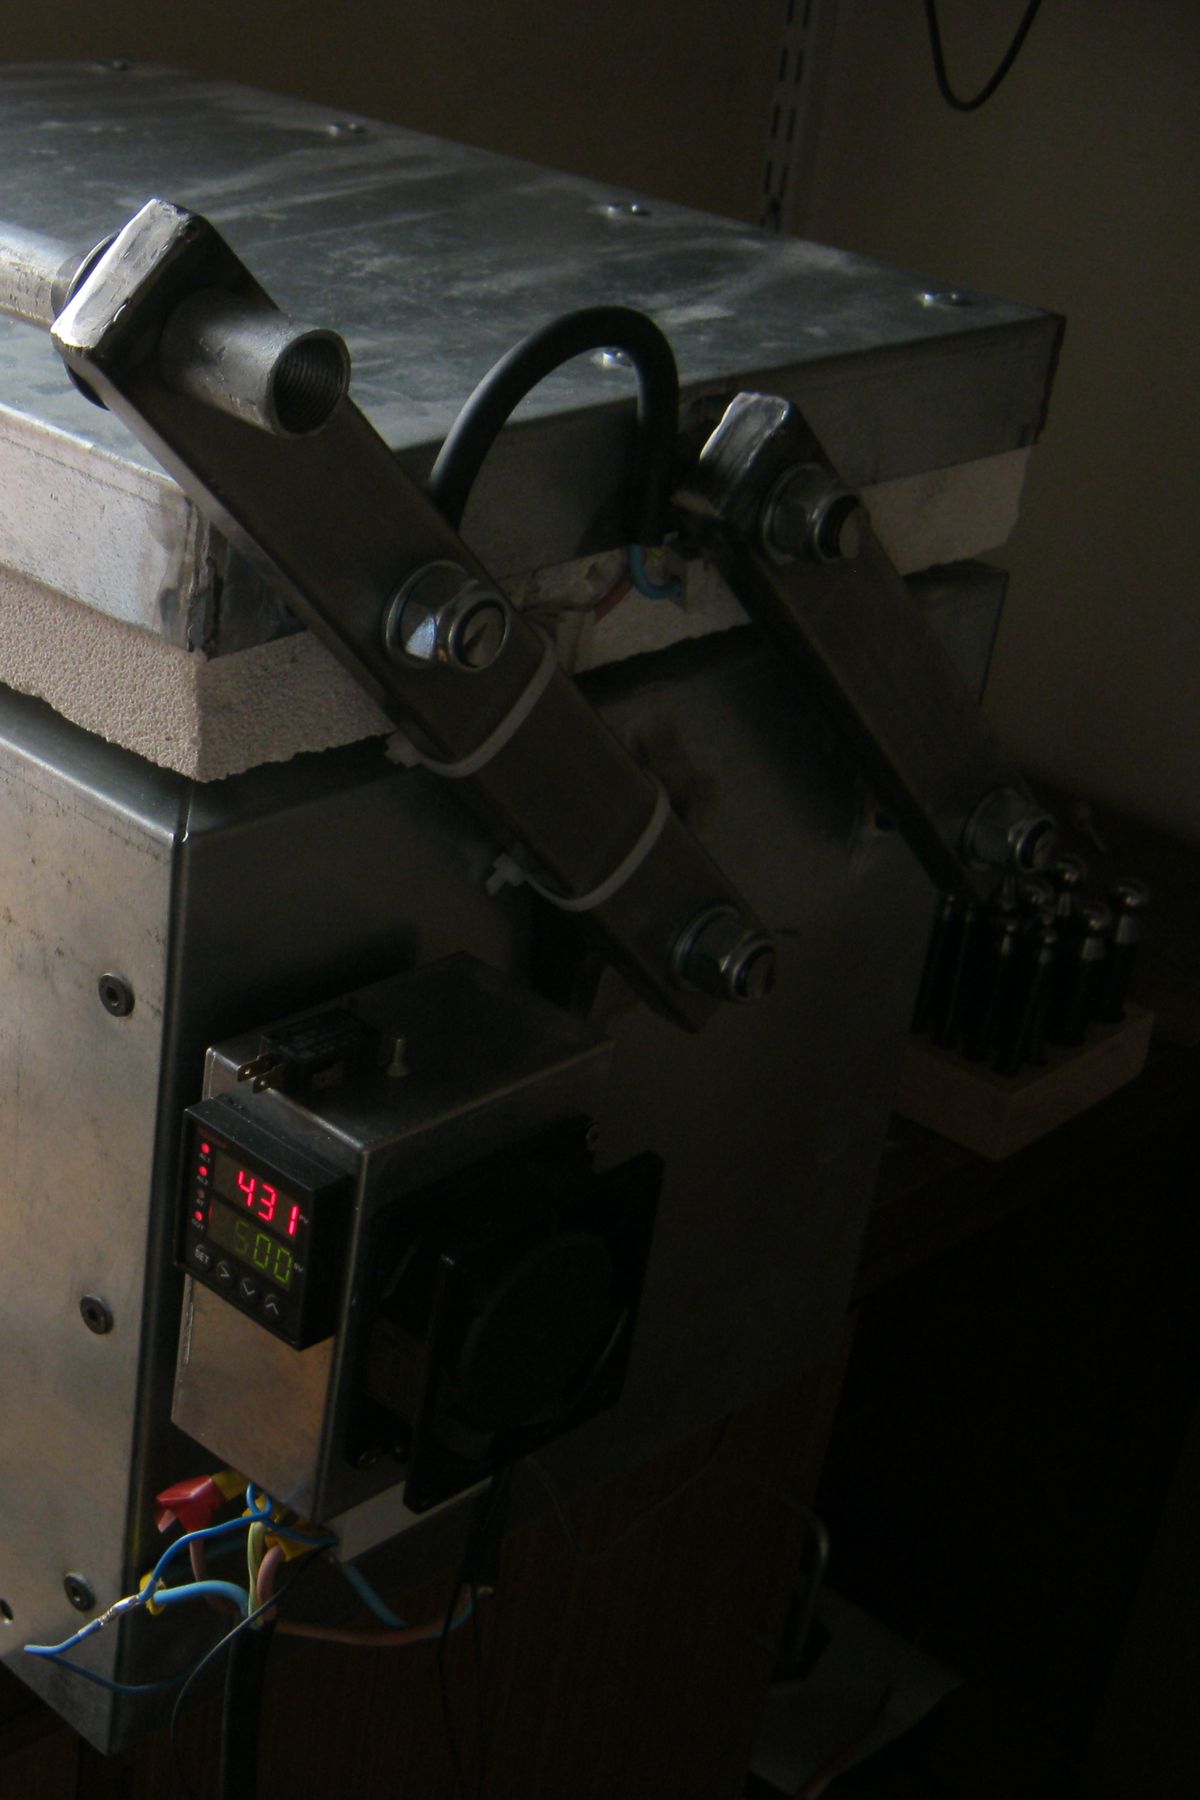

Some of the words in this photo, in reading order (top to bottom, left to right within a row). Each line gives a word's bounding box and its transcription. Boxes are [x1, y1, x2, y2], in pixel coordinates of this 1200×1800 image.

[238, 1170, 300, 1236] 431
[194, 1247, 209, 1264] SET
[236, 1220, 293, 1284] 500
